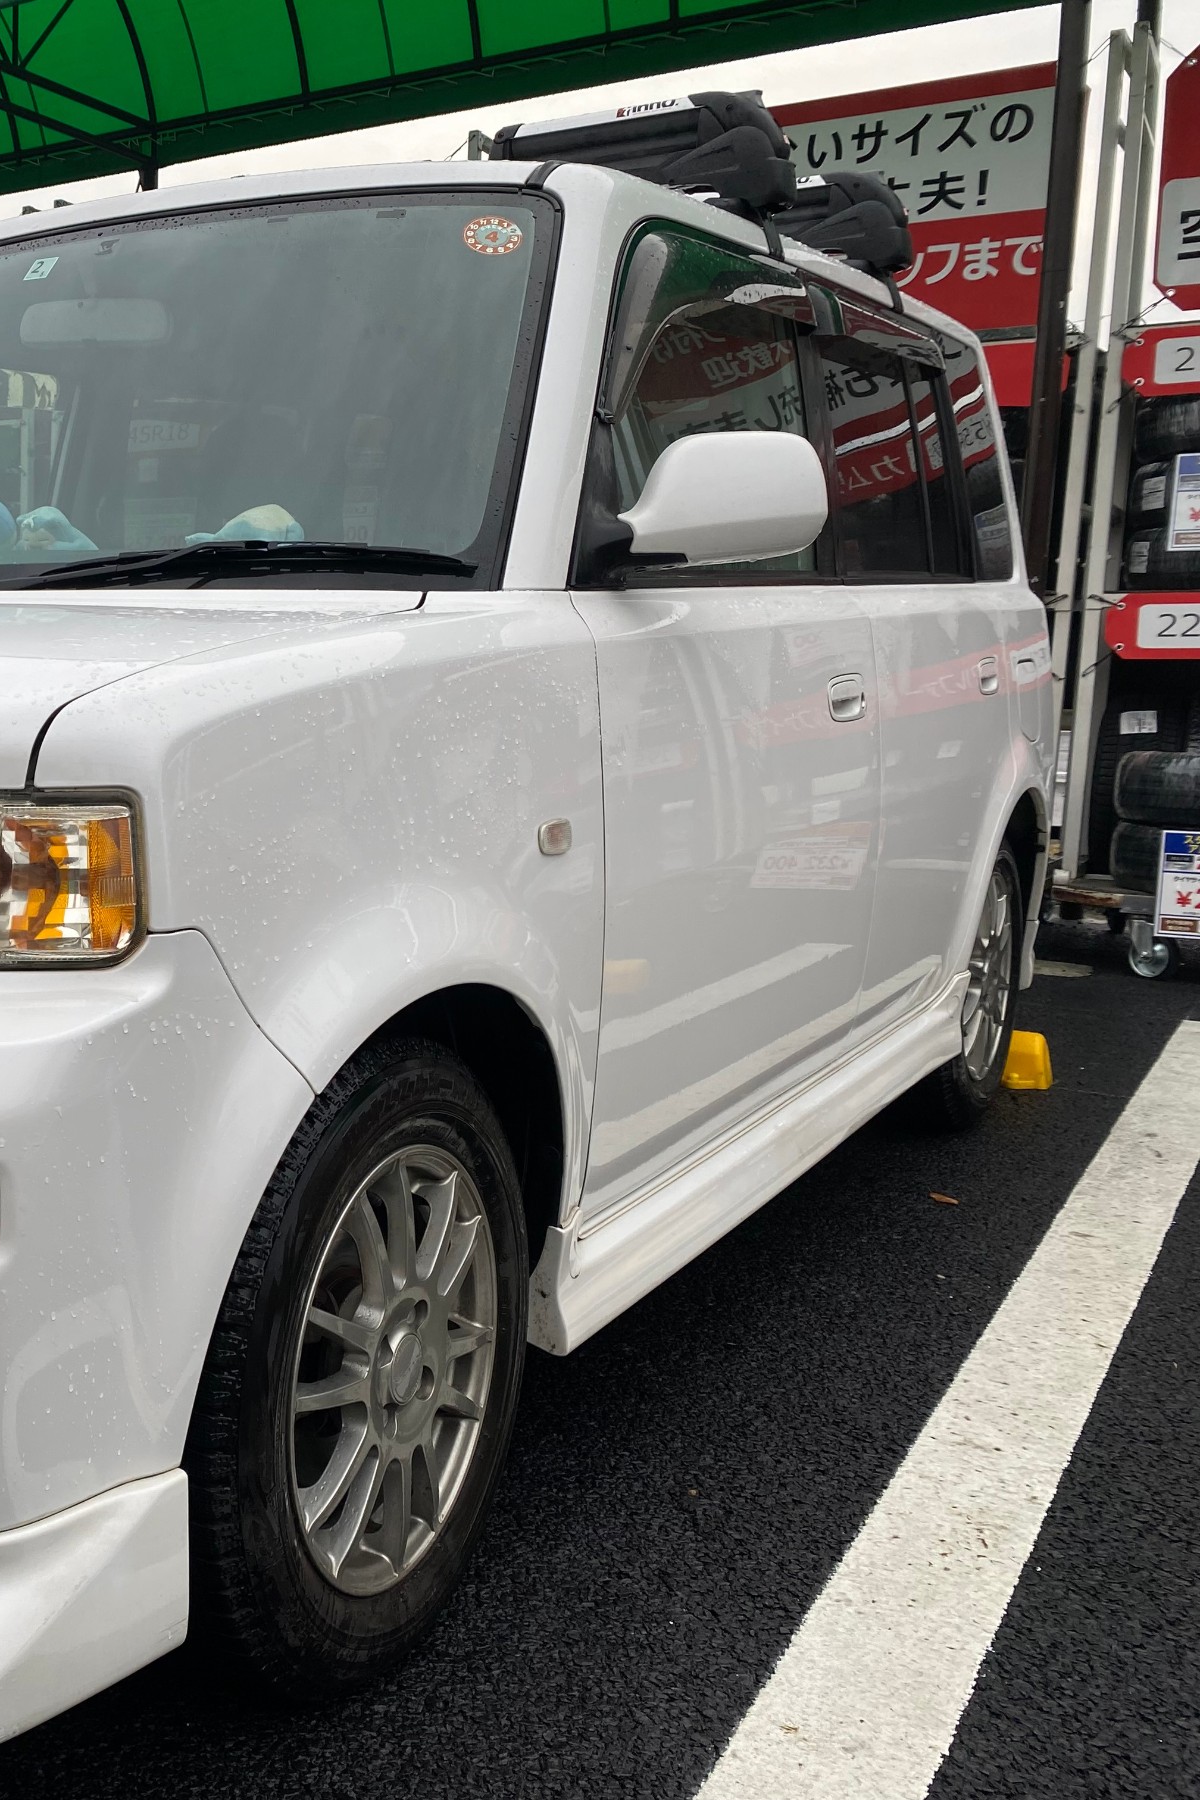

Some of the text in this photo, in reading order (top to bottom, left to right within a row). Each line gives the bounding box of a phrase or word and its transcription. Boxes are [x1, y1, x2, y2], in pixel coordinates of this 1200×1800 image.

[789, 103, 1034, 168] いサイズの
[1157, 613, 1200, 638] 22
